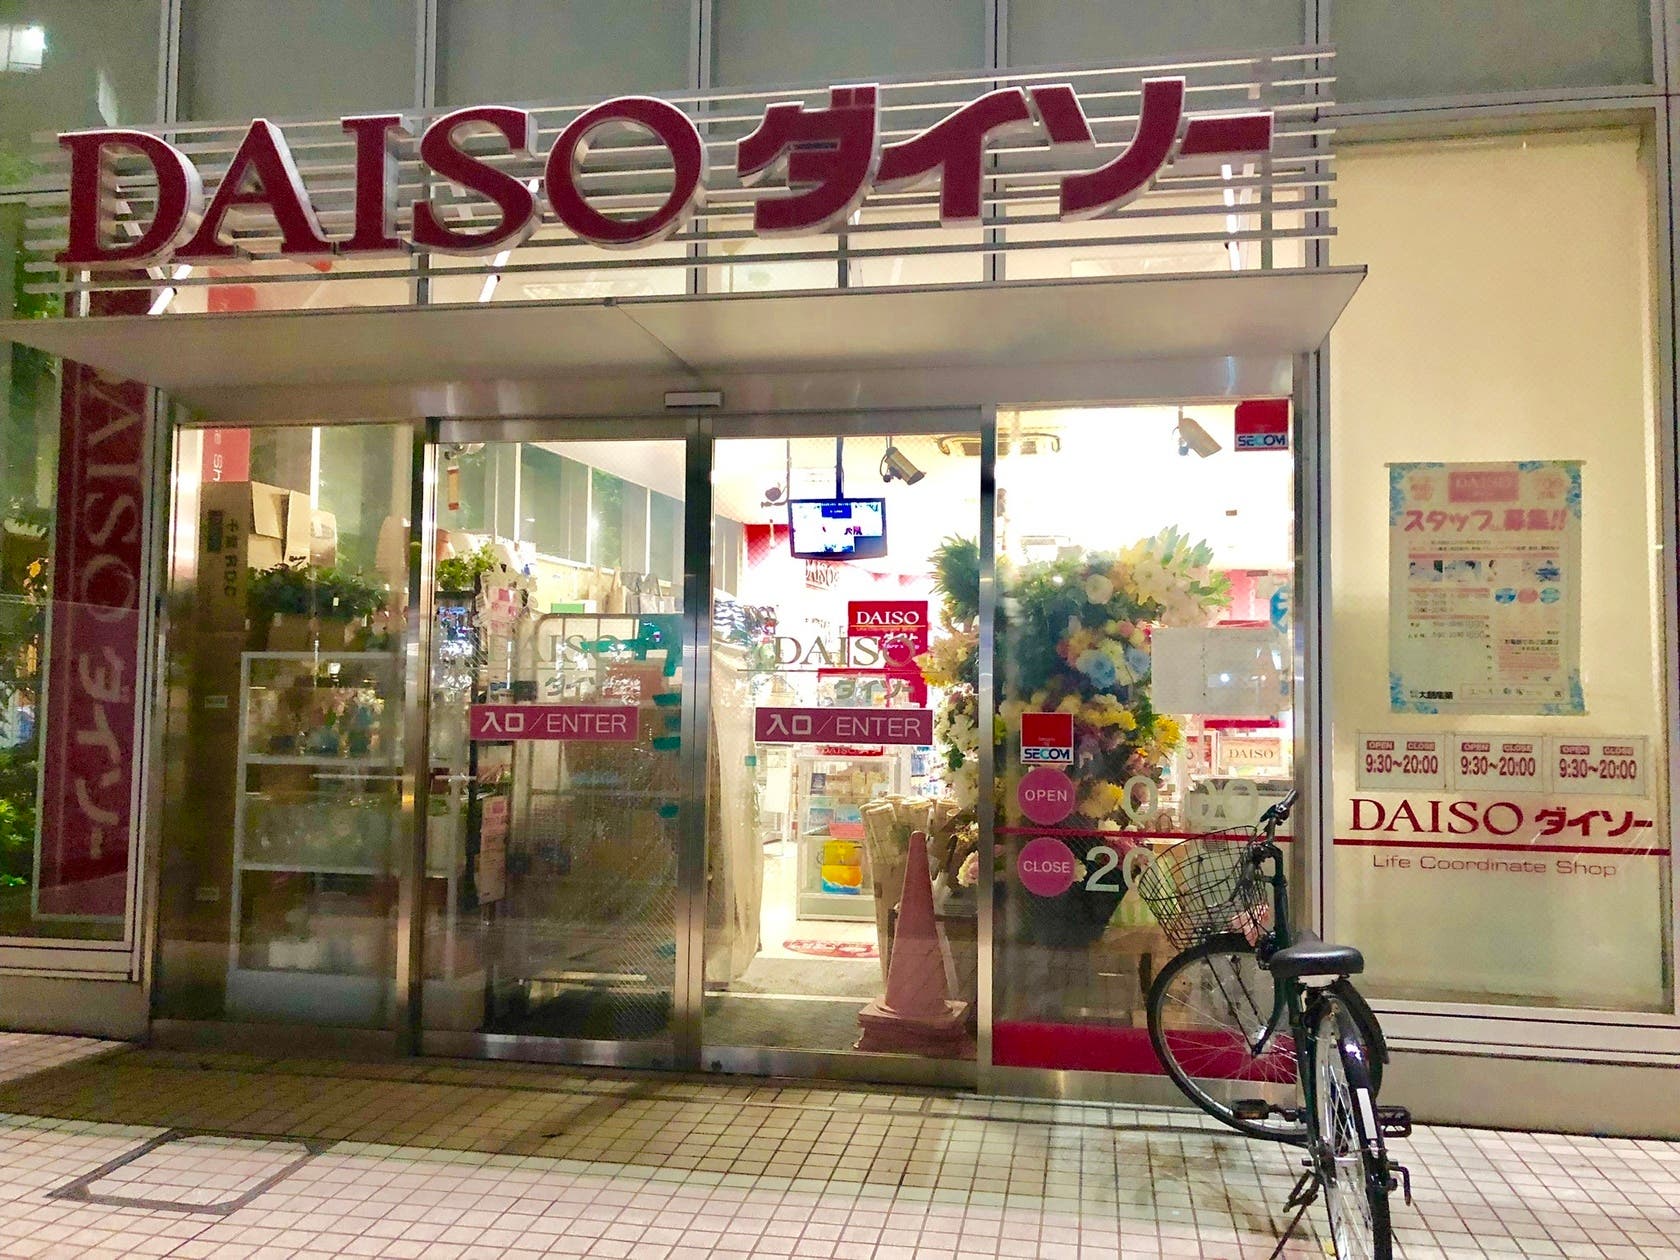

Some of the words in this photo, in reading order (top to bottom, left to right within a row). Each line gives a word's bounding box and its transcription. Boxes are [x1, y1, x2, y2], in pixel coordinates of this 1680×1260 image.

[57, 95, 708, 270] DAISO
[736, 75, 1274, 238] ダイソー
[1237, 434, 1286, 446] SECOM
[856, 611, 920, 625] DAISO
[774, 636, 916, 668] DAISO
[1368, 742, 1393, 750] OPEN
[1463, 743, 1489, 752] OPEN
[1024, 748, 1070, 760] SECOM
[1229, 748, 1274, 759] DAISO
[1025, 789, 1067, 802] OPEN
[1349, 798, 1524, 836] DAISO
[1534, 806, 1653, 837] ダイソー
[1023, 860, 1071, 874] CLOSE
[1373, 854, 1411, 869] Life
[1420, 856, 1547, 874] Coordinate
[1556, 860, 1617, 878] Shop
